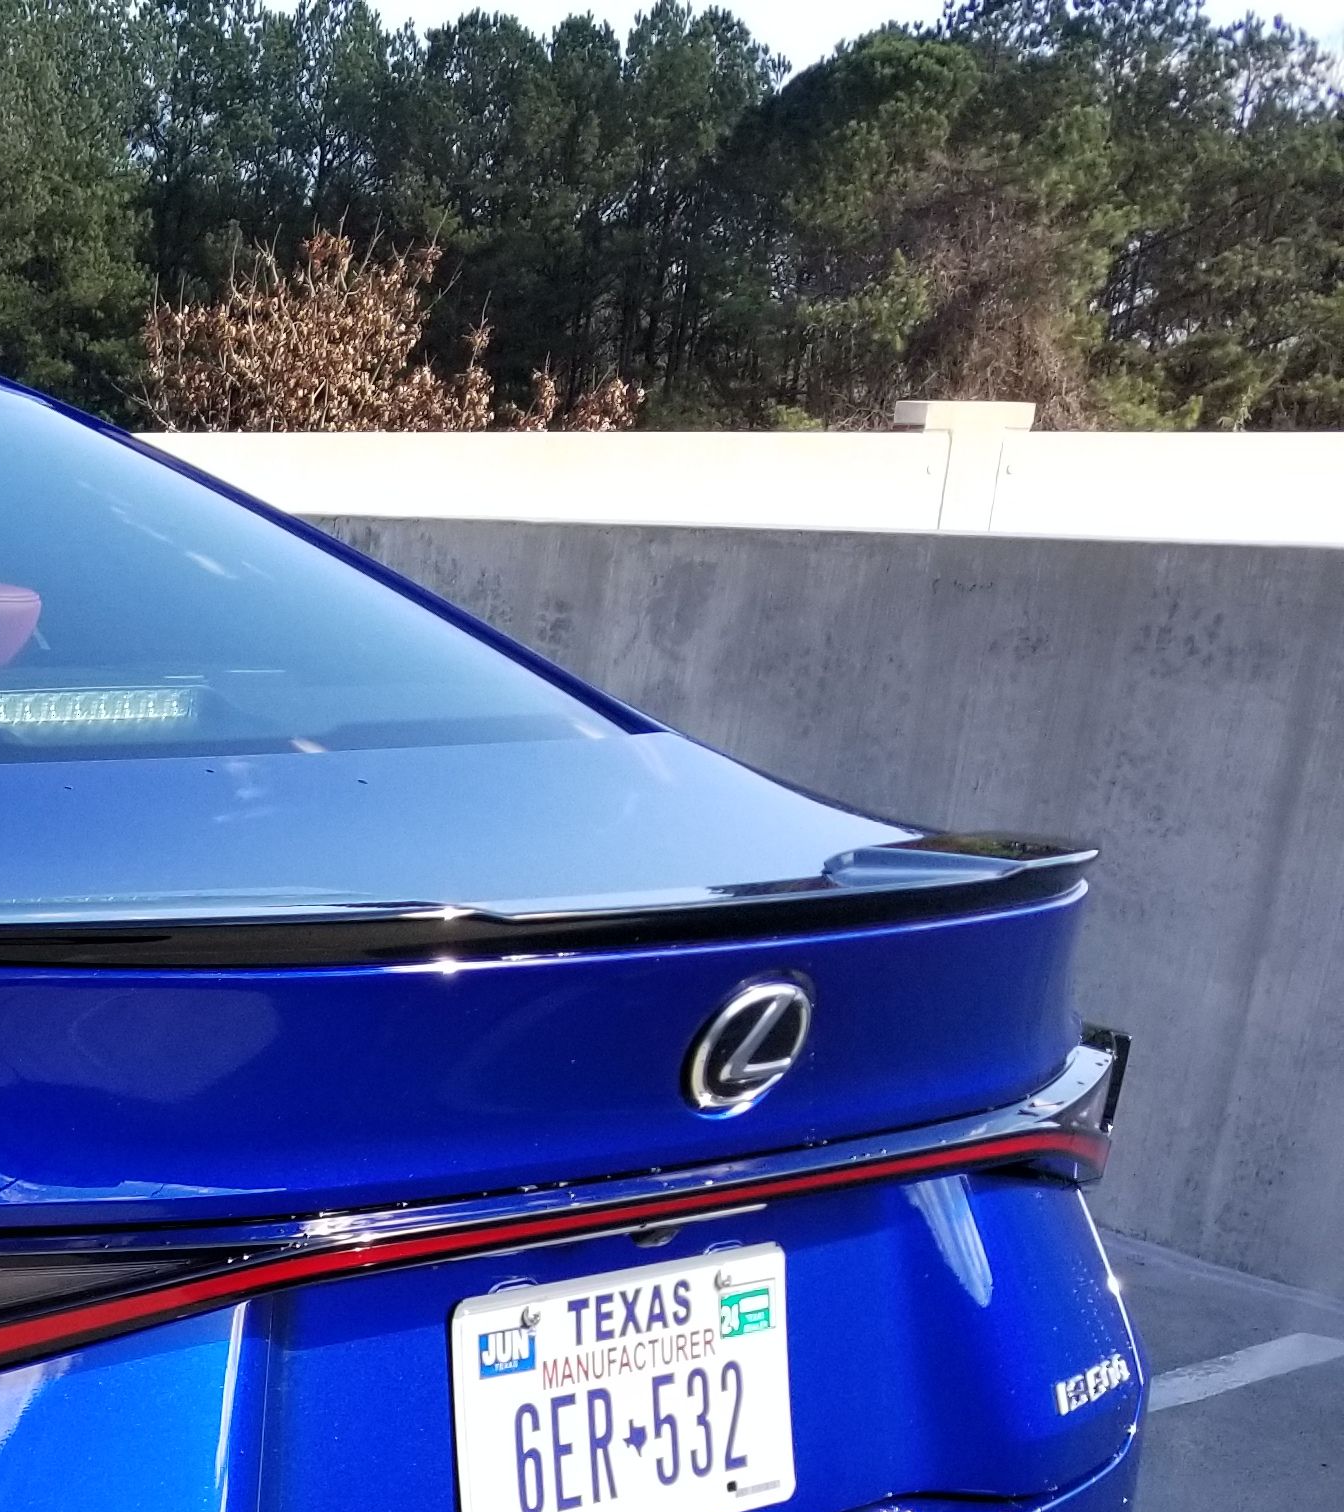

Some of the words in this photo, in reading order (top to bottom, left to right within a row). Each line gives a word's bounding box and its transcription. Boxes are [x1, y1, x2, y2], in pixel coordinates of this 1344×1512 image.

[567, 1279, 692, 1346] TEXAS
[482, 1329, 529, 1366] JUN
[542, 1328, 716, 1390] MANUFACTURER
